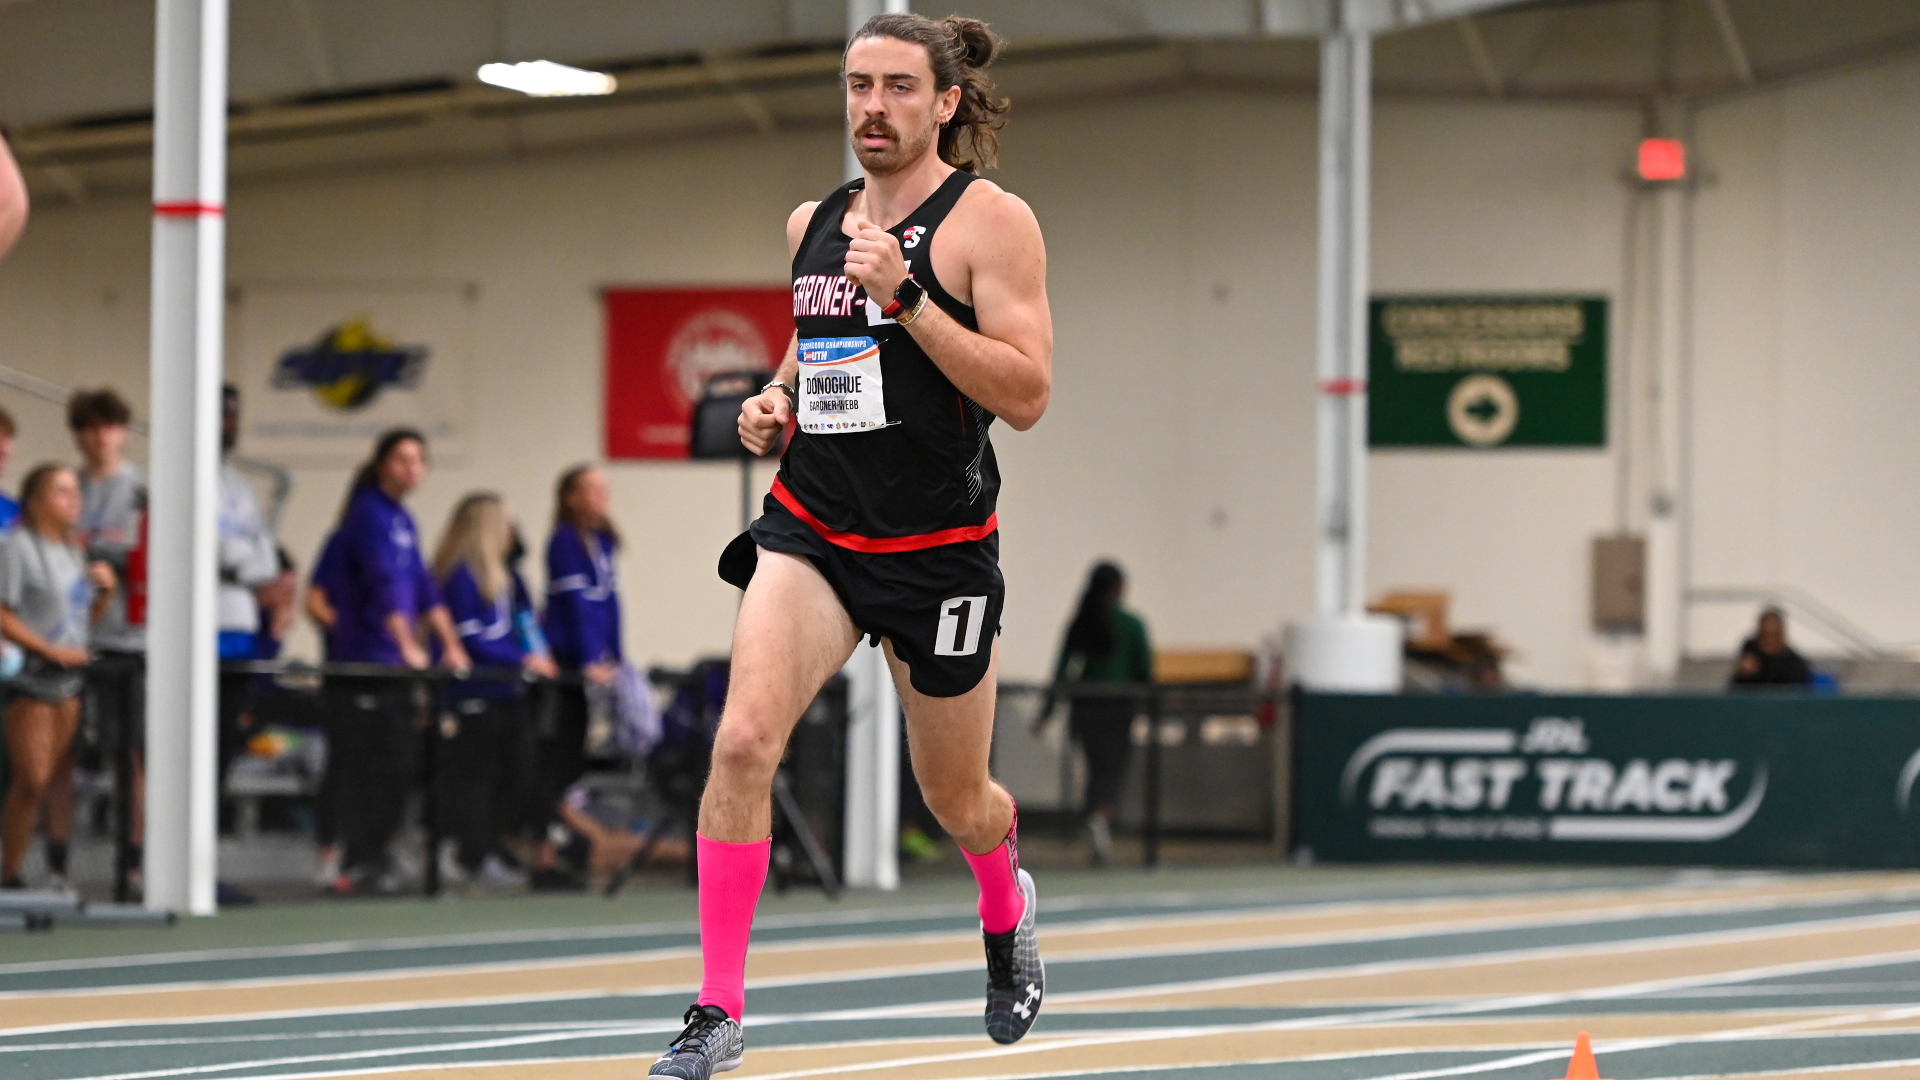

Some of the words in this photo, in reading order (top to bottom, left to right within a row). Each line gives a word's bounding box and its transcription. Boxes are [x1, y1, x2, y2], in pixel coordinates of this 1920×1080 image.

[806, 375, 862, 395] DONOGHUE
[809, 399, 859, 412] GARDNER-WEBB
[947, 600, 972, 652] 1
[1369, 758, 1526, 811] FAST
[1538, 758, 1736, 811] TRACK
